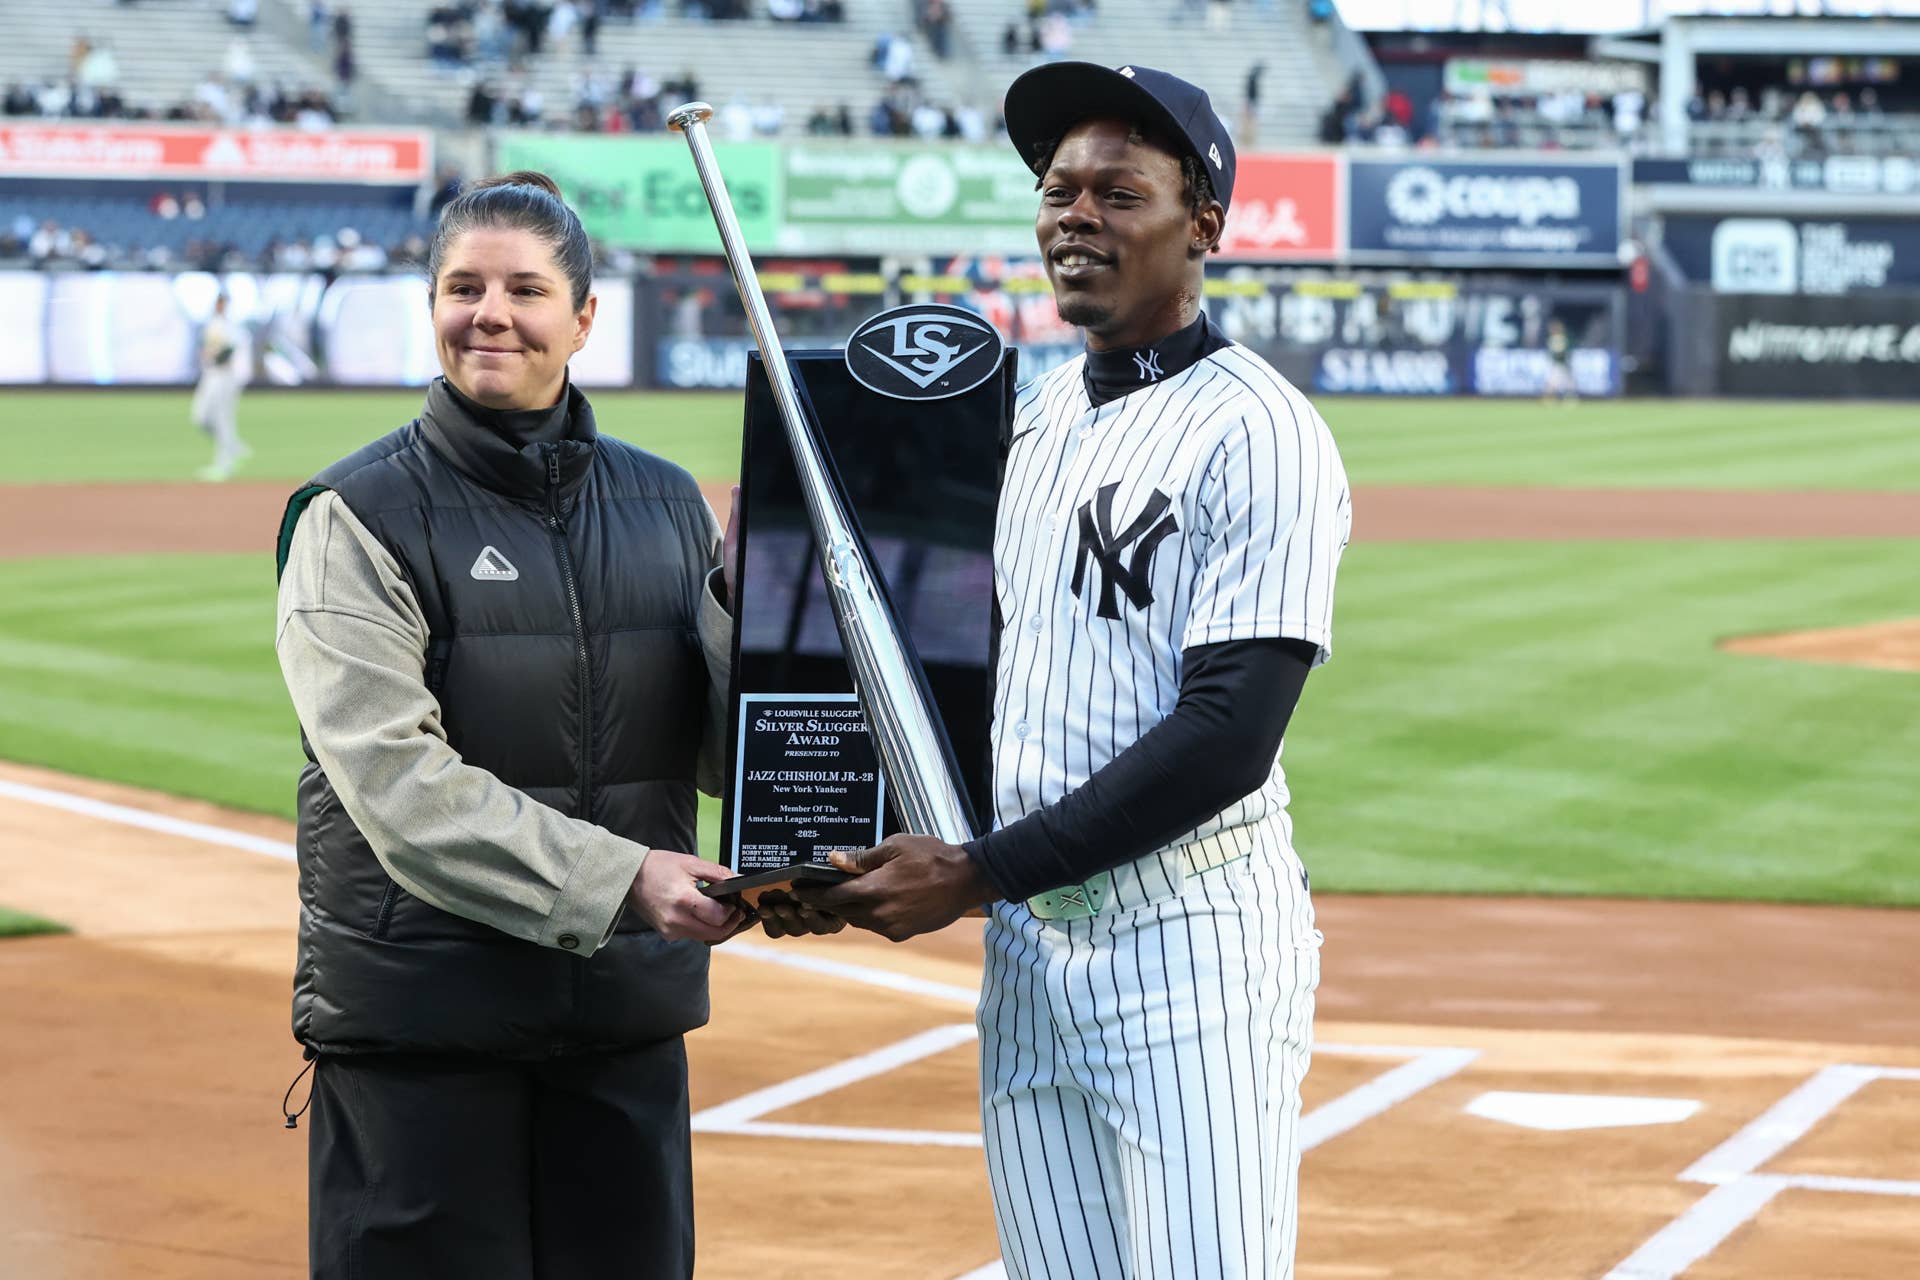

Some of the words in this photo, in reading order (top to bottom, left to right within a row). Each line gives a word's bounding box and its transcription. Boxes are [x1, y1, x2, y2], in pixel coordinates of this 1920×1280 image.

[1070, 481, 1180, 621] NY
[774, 710, 819, 718] LOUISVILLE
[755, 719, 805, 732] SILVER
[805, 719, 868, 732] SLUGGER
[785, 732, 840, 746] AWARD
[747, 770, 776, 781] JAZZ
[777, 770, 840, 782] CHISHOLM
[772, 784, 791, 793] New
[793, 785, 813, 793] York
[814, 785, 848, 794] Yankees
[780, 805, 811, 813] Member
[812, 805, 822, 813] Of
[823, 805, 839, 813] The
[746, 815, 783, 823] American
[785, 815, 812, 825] League
[813, 815, 849, 824] Offensive
[849, 816, 871, 824] Team
